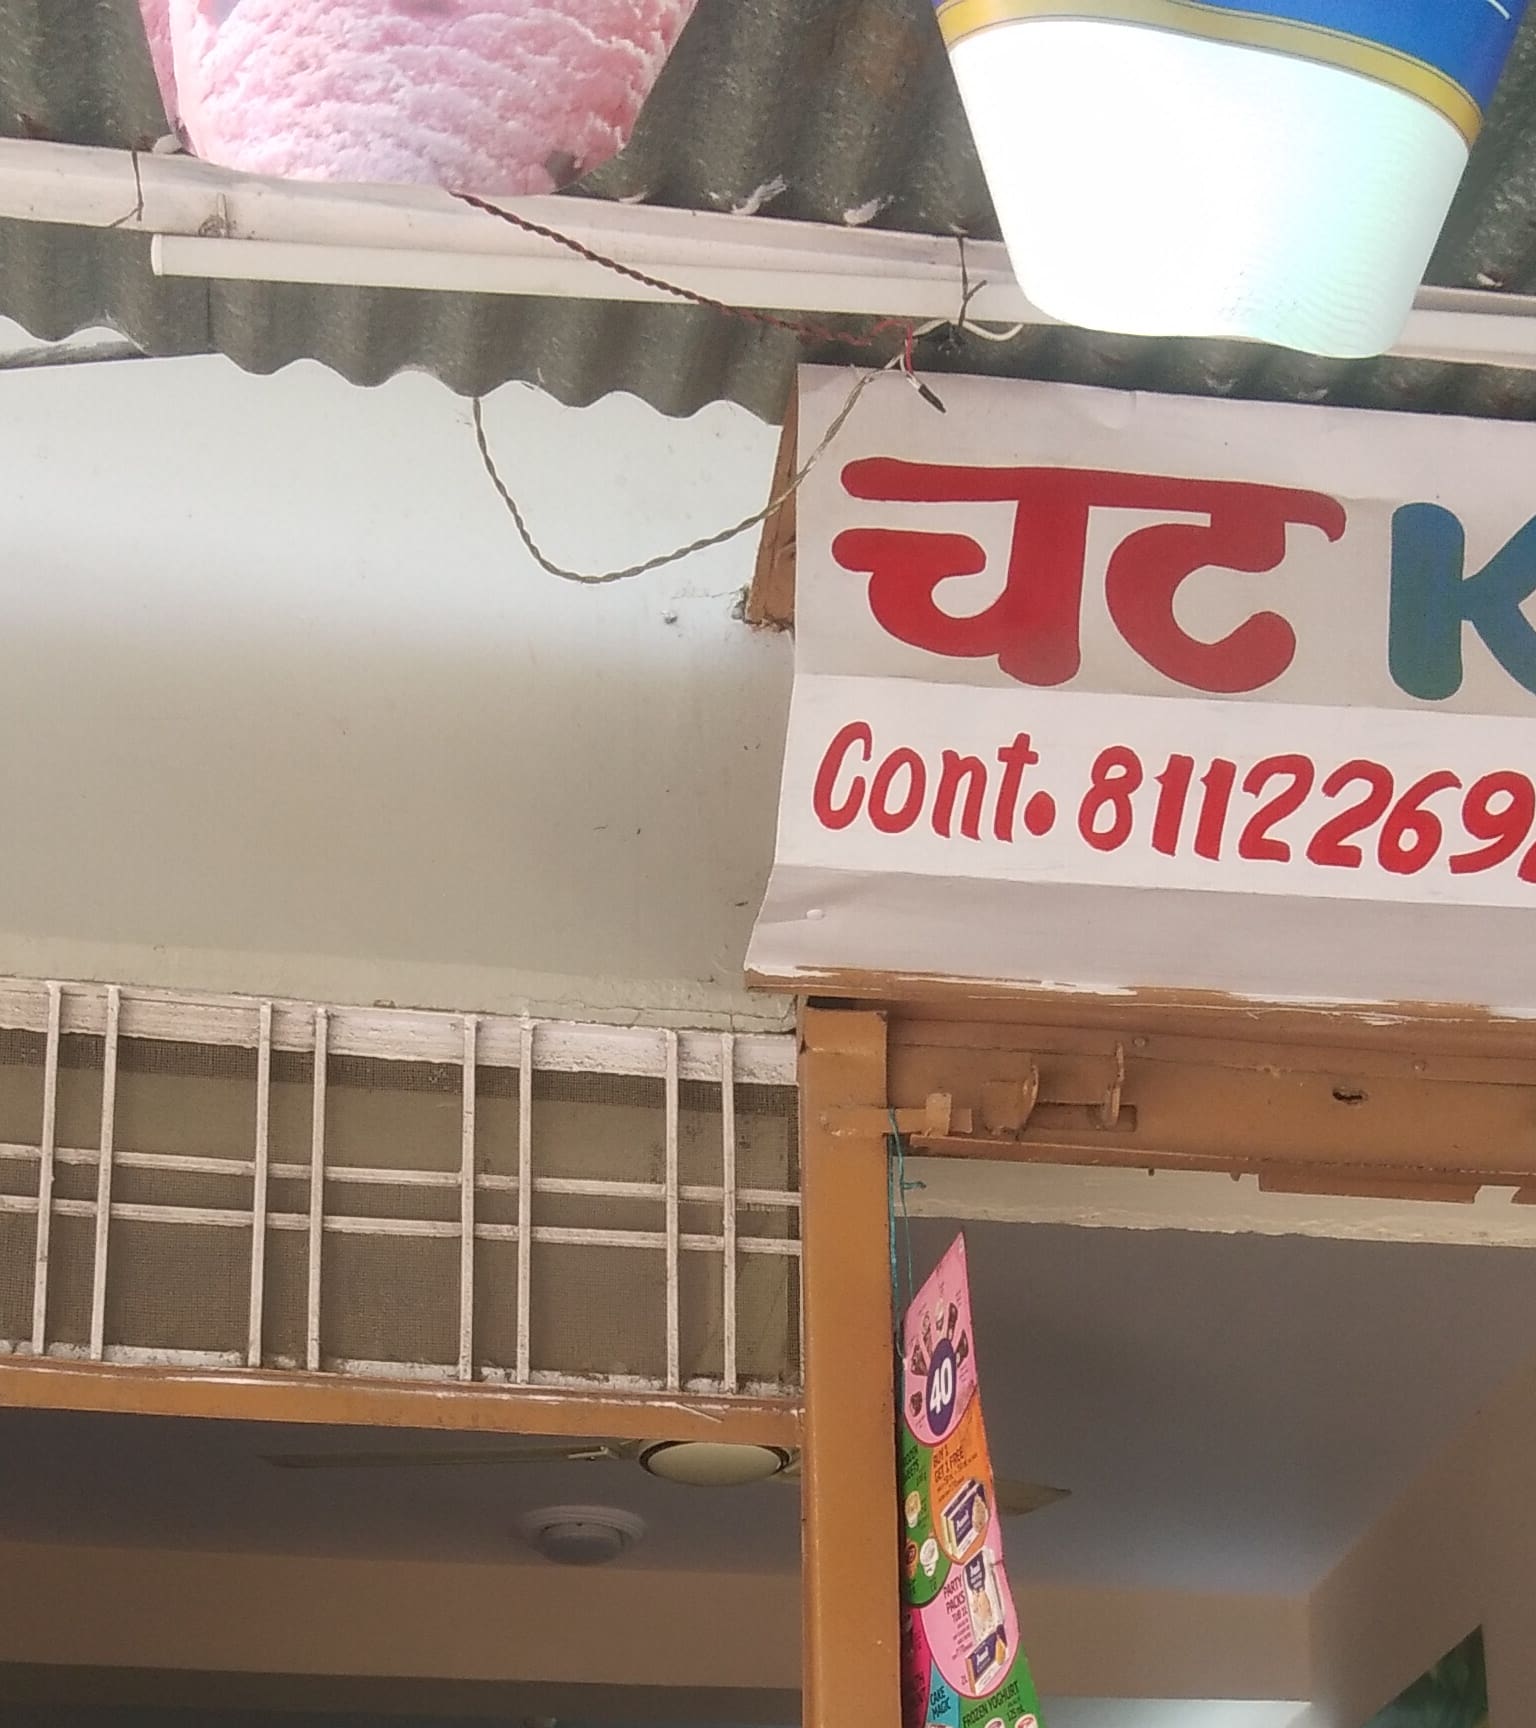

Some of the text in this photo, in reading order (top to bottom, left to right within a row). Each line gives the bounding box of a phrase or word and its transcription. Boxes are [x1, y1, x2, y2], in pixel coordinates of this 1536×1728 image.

[831, 456, 1346, 693] चट
[812, 719, 1057, 843] Cont.
[930, 1357, 953, 1416] 40
[962, 1704, 989, 1728] FROZEN
